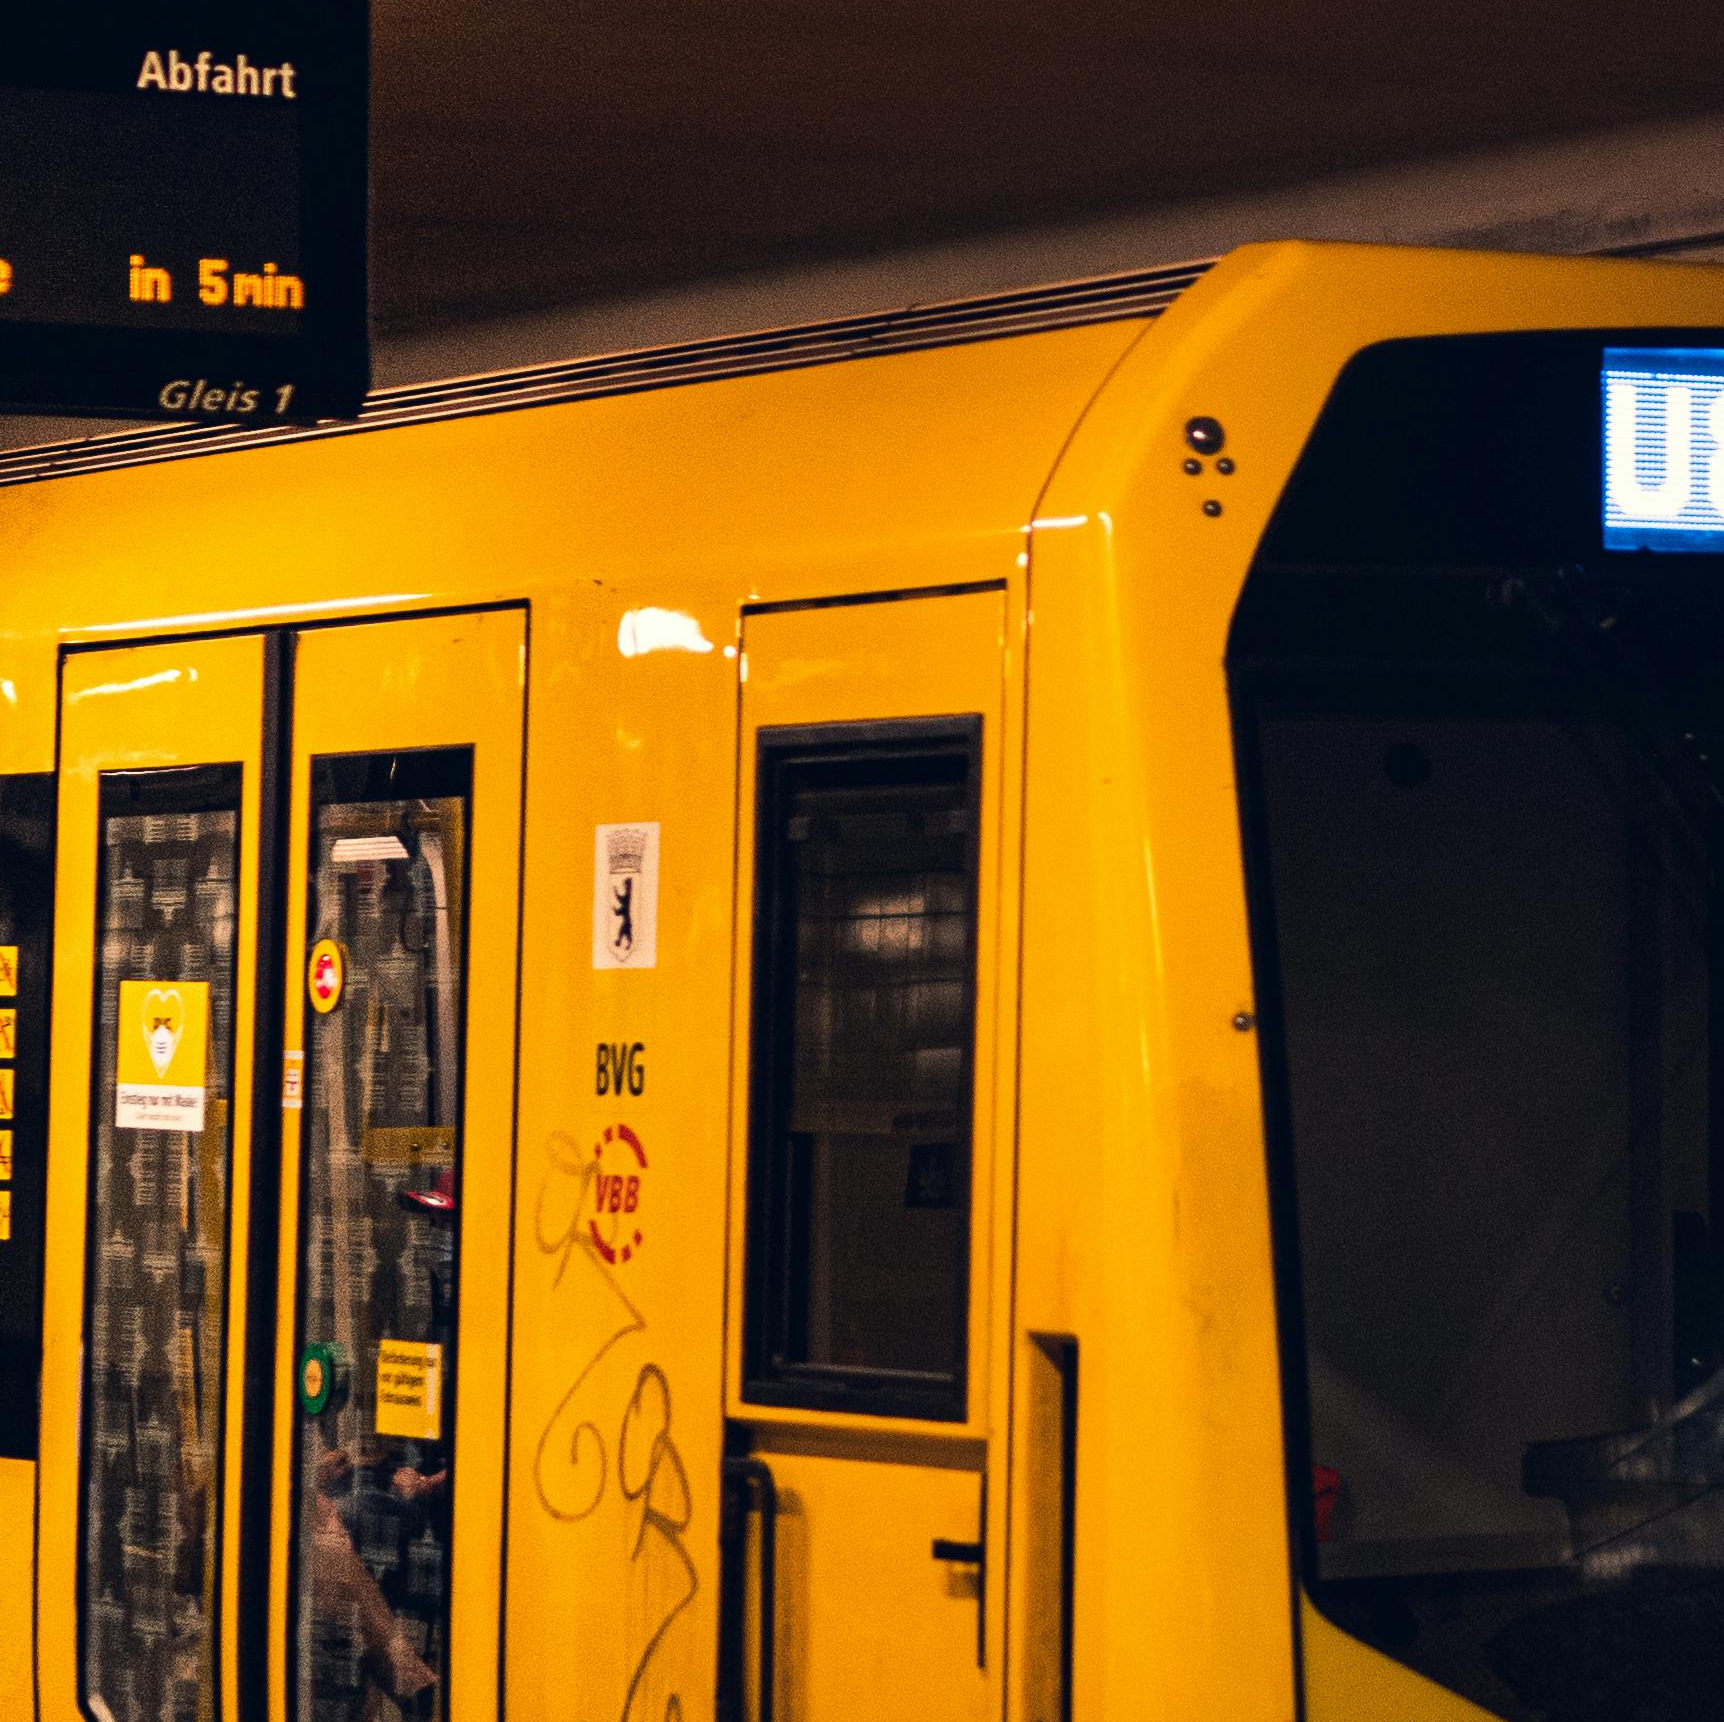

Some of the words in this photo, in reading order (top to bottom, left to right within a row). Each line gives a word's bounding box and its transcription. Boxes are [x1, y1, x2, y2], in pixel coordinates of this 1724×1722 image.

[136, 49, 297, 99] Abfahrt
[129, 254, 171, 303] in
[159, 379, 261, 413] Gleis
[274, 383, 296, 414] 1
[595, 1041, 646, 1097] BVG
[595, 1174, 641, 1214] VBB
